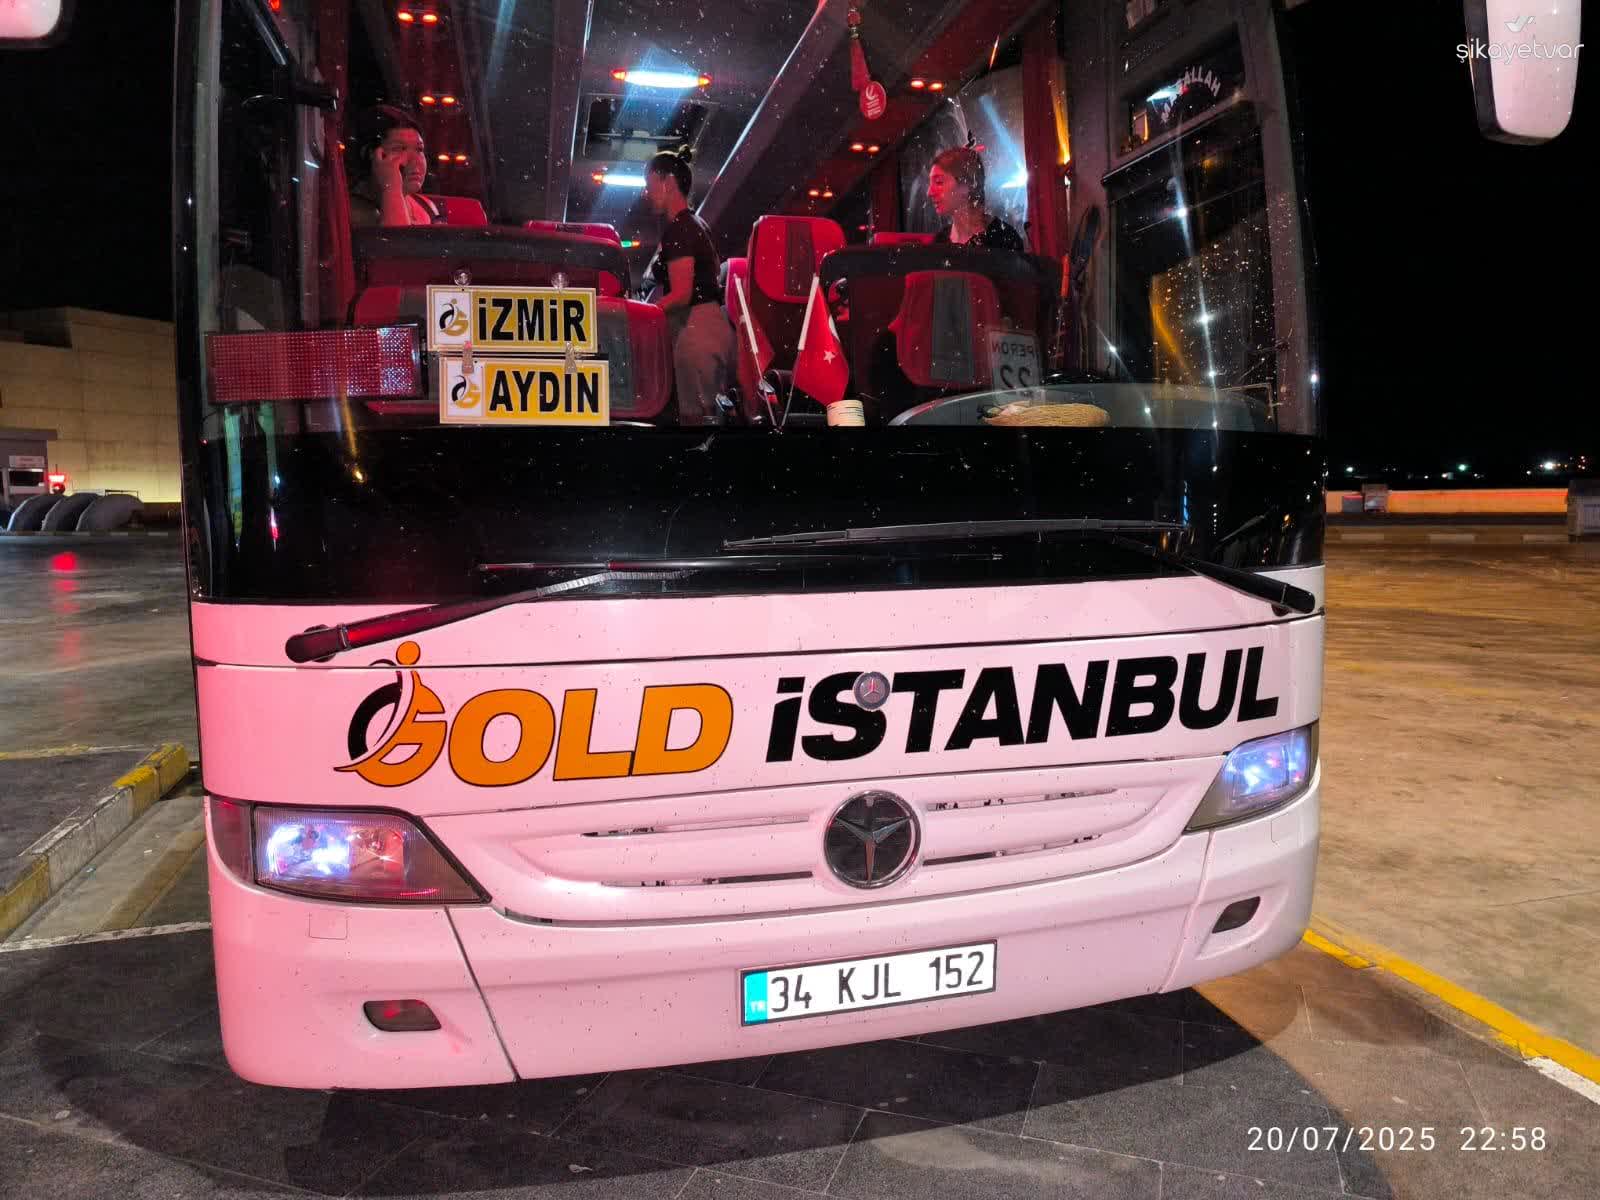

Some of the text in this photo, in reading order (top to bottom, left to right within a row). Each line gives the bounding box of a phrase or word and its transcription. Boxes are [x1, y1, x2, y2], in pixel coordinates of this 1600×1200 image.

[489, 370, 599, 413] AYDIN
[333, 641, 734, 788] GOLD
[770, 974, 812, 1012] 34
[838, 963, 901, 1004] KJL
[929, 951, 985, 991] 152
